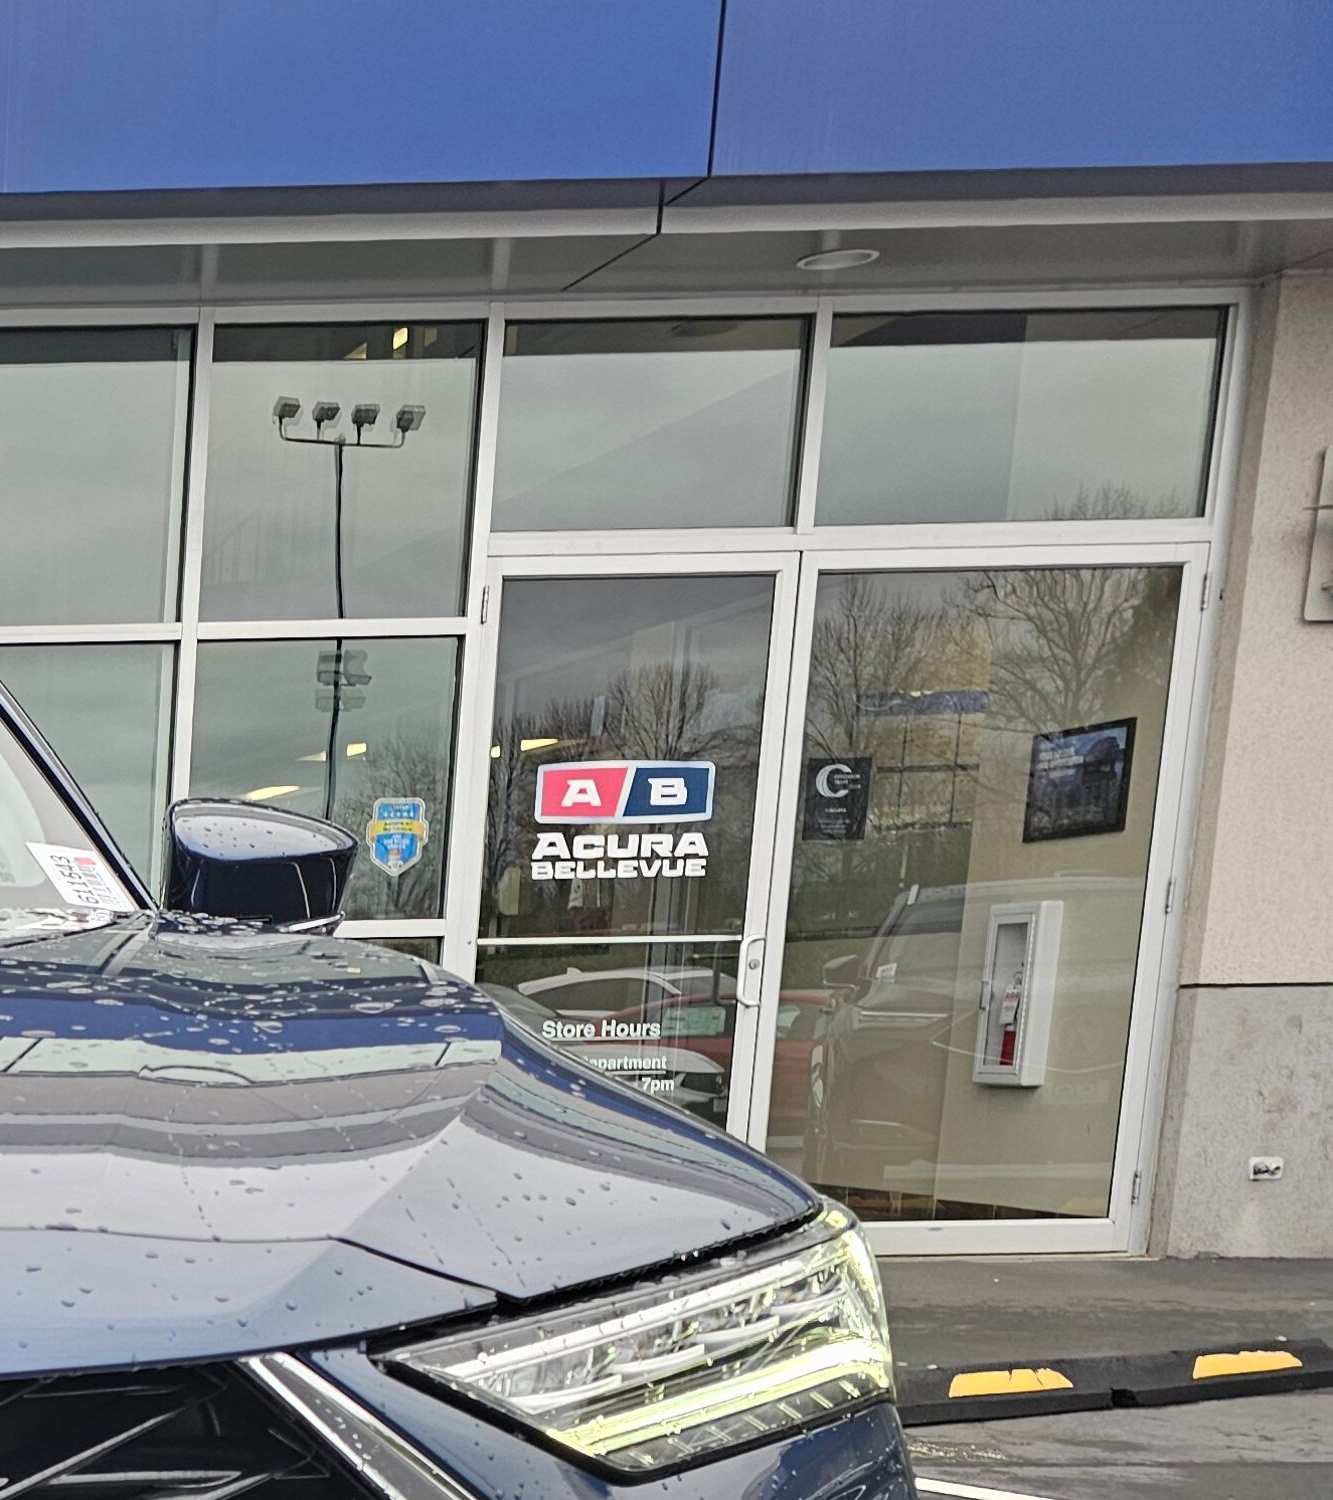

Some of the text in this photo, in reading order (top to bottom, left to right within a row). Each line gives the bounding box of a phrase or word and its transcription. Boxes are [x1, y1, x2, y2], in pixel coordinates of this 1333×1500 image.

[561, 777, 688, 807] A B
[532, 832, 709, 860] ACURA
[531, 858, 707, 880] BELLEVUE
[542, 1019, 661, 1039] Store Hours
